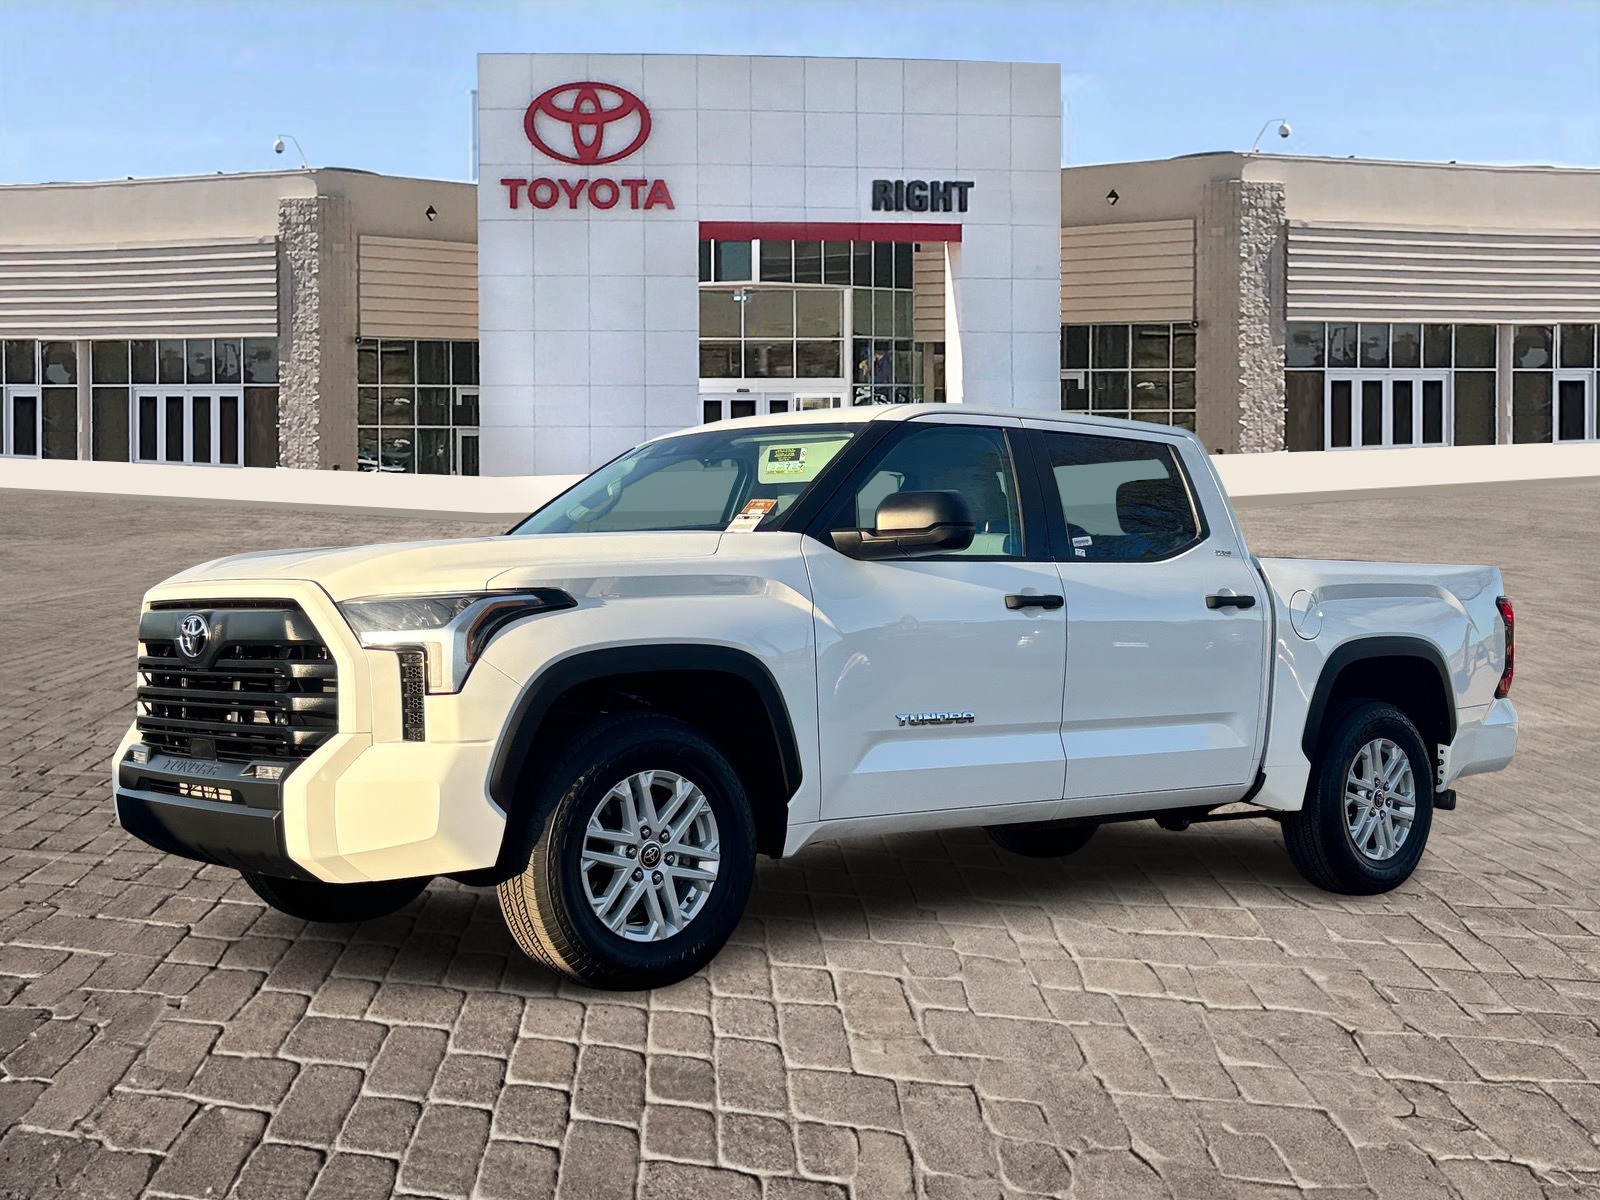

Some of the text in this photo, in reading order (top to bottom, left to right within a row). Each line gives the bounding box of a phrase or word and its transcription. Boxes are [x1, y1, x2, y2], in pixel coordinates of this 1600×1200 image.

[501, 178, 675, 210] TOYOTA
[872, 180, 975, 212] RIGHT
[895, 710, 975, 727] TUNDRA
